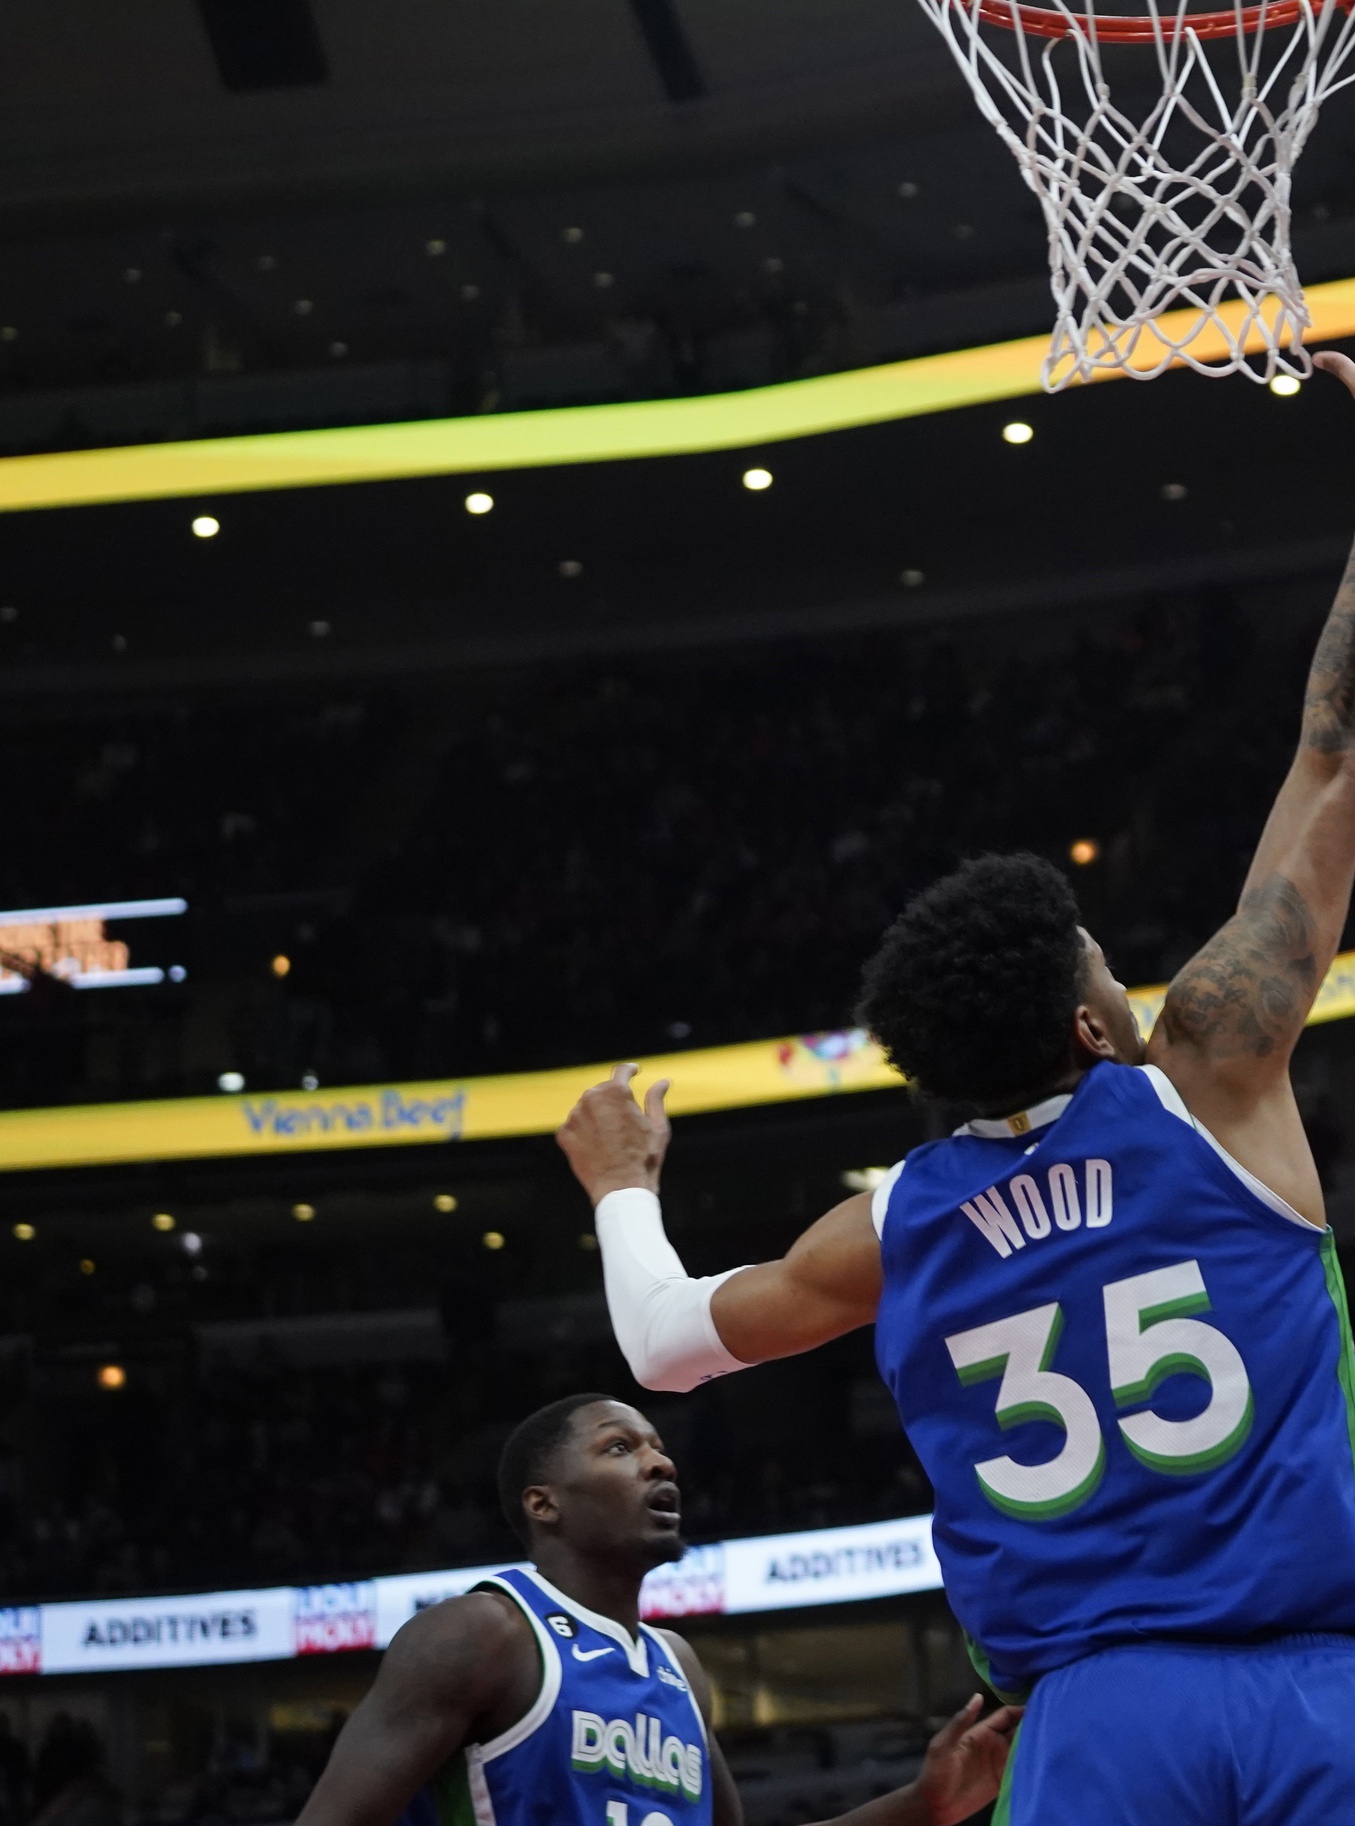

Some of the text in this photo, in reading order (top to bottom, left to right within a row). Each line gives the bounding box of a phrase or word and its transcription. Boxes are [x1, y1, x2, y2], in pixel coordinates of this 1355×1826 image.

[960, 1159, 1113, 1259] WOOD
[944, 1259, 1256, 1521] 35
[764, 1538, 923, 1584] ADDITIVES
[81, 1607, 259, 1649] ADDITIVES
[547, 1615, 574, 1638] 6
[571, 1708, 703, 1804] Dallas
